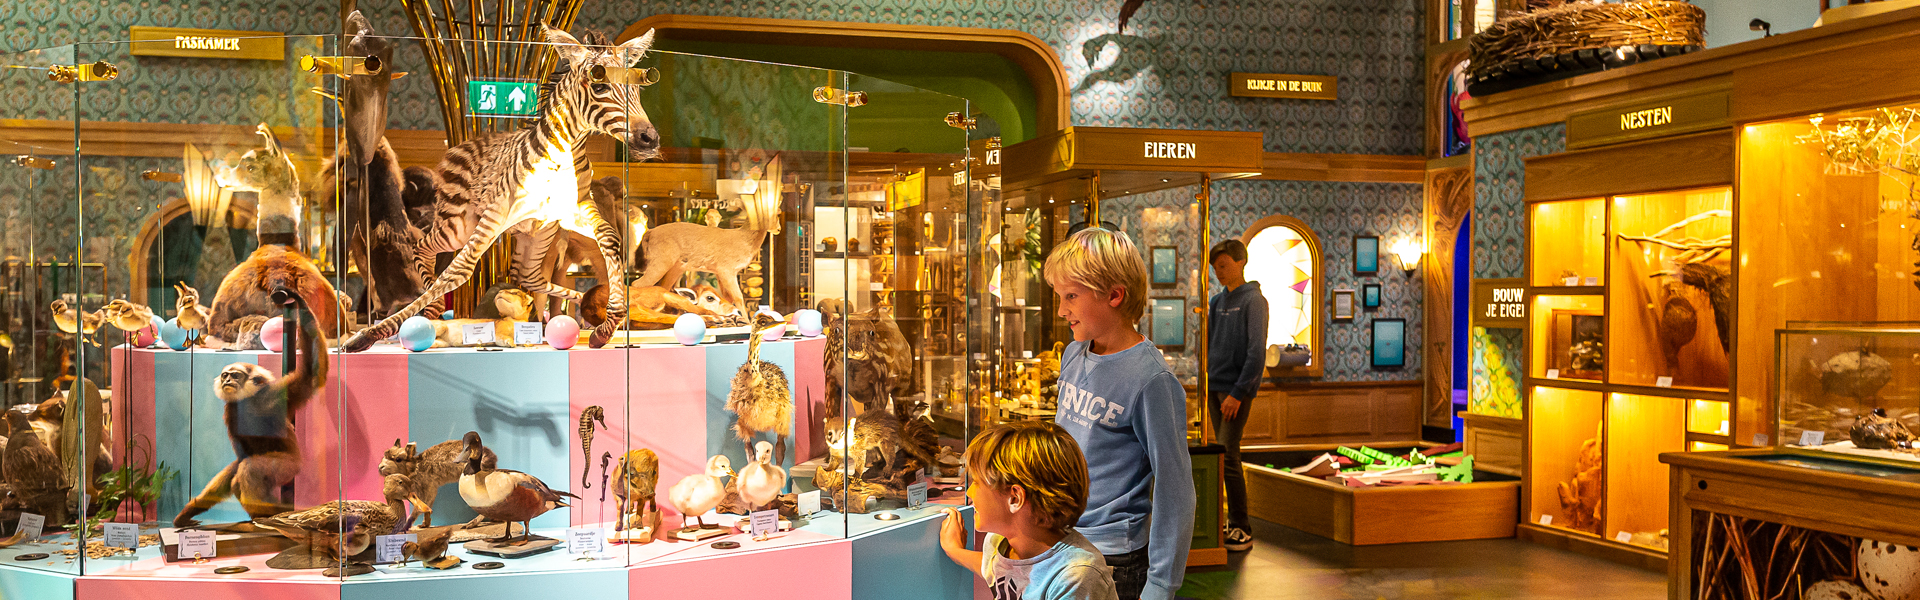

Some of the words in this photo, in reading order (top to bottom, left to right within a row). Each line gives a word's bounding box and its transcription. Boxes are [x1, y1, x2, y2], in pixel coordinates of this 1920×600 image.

[175, 35, 240, 50] PASKAMER
[1277, 80, 1287, 91] IN
[1289, 80, 1300, 92] DE
[1302, 81, 1322, 92] BUIK
[1620, 105, 1672, 131] NESTEN
[1144, 141, 1196, 160] EIEREN
[1493, 287, 1525, 303] BOUW
[1485, 303, 1497, 318] JE
